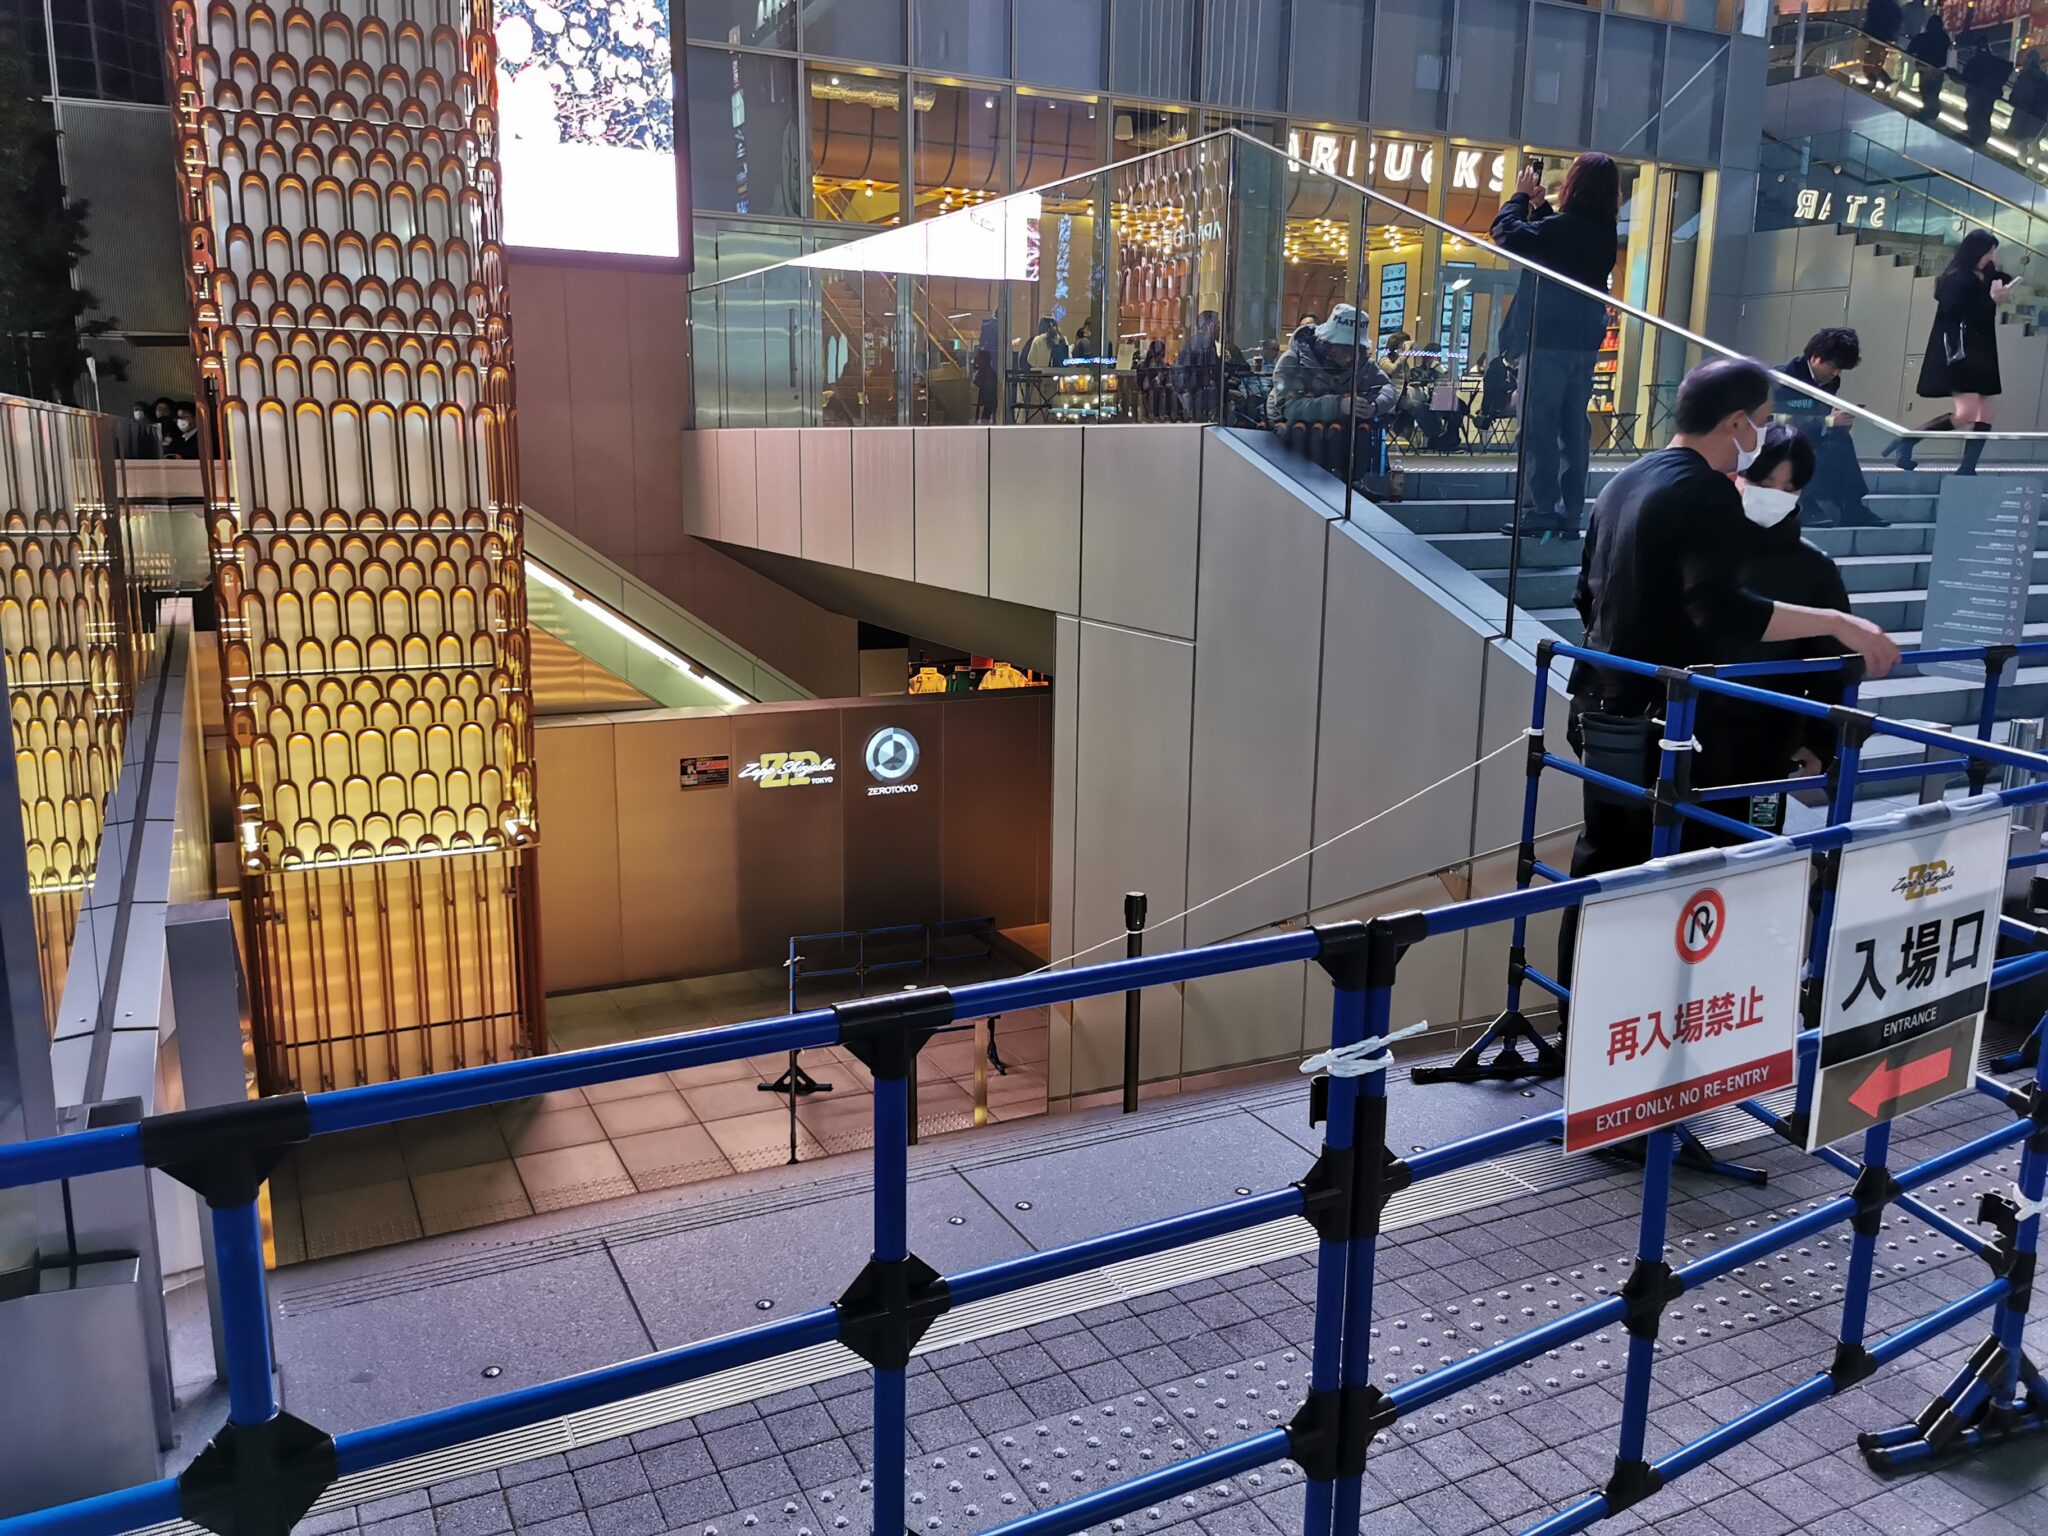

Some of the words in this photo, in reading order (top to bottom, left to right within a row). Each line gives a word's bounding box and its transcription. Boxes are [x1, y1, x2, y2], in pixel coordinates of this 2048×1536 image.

[811, 776, 834, 785] TOKYO
[867, 784, 919, 796] ZEROTOKYO
[1841, 909, 1985, 1012] 入場口
[1607, 985, 1763, 1066] 再入場禁止
[1883, 1006, 1938, 1037] ENTRANCE
[1596, 1107, 1632, 1132] EXIT
[1635, 1094, 1675, 1120] ONLY.
[1679, 1087, 1700, 1108] NO
[1704, 1065, 1770, 1099] RE-ENTRY
